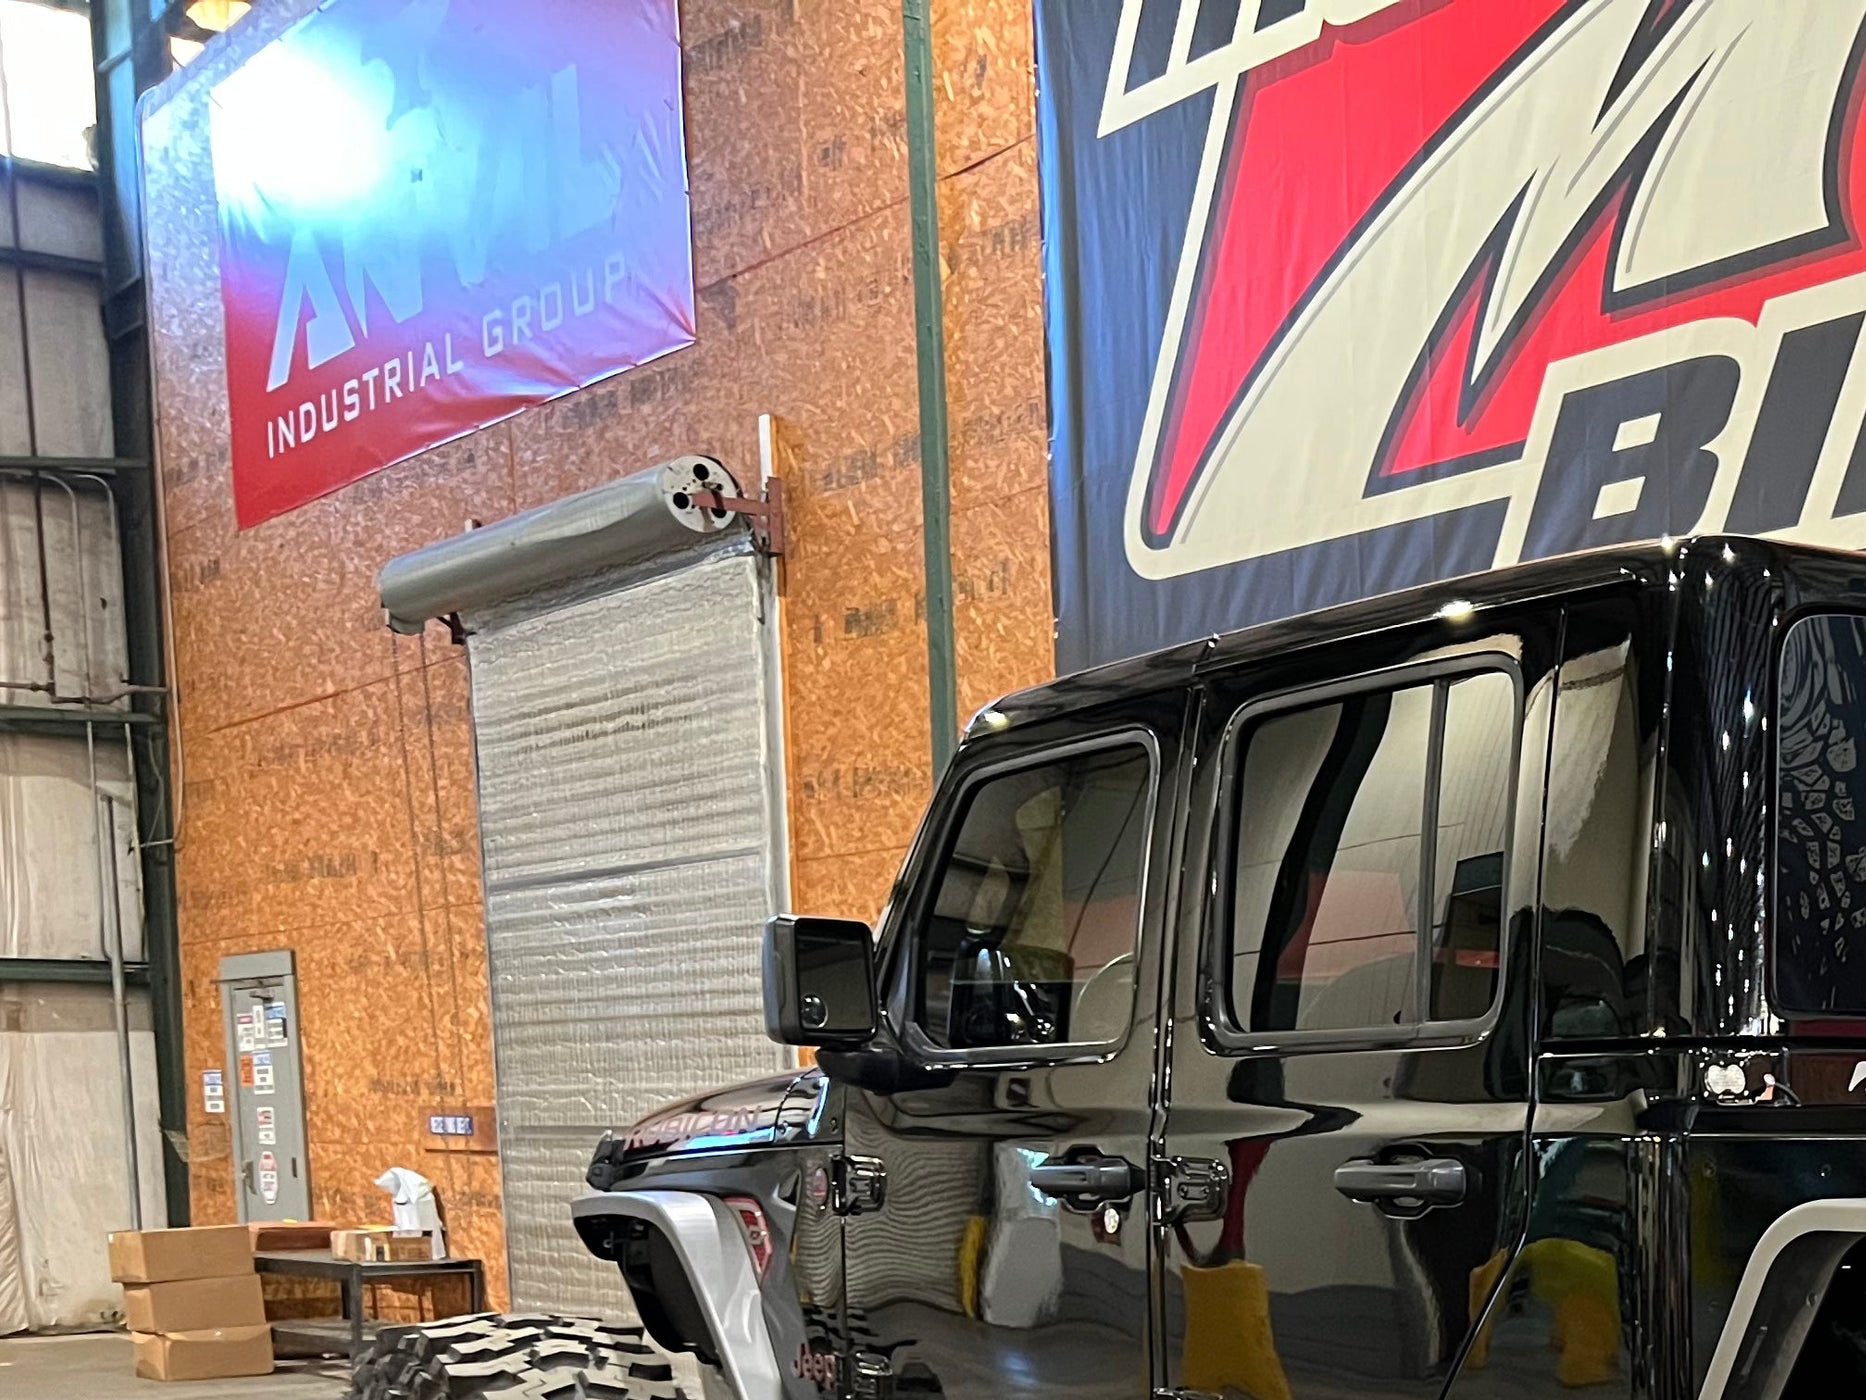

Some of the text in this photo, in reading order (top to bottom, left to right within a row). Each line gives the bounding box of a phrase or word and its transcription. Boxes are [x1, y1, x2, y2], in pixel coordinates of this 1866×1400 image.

[266, 62, 622, 394] ANVIL
[266, 252, 627, 459] INDUSTRIAL GROUP
[794, 1343, 837, 1393] Jeep
